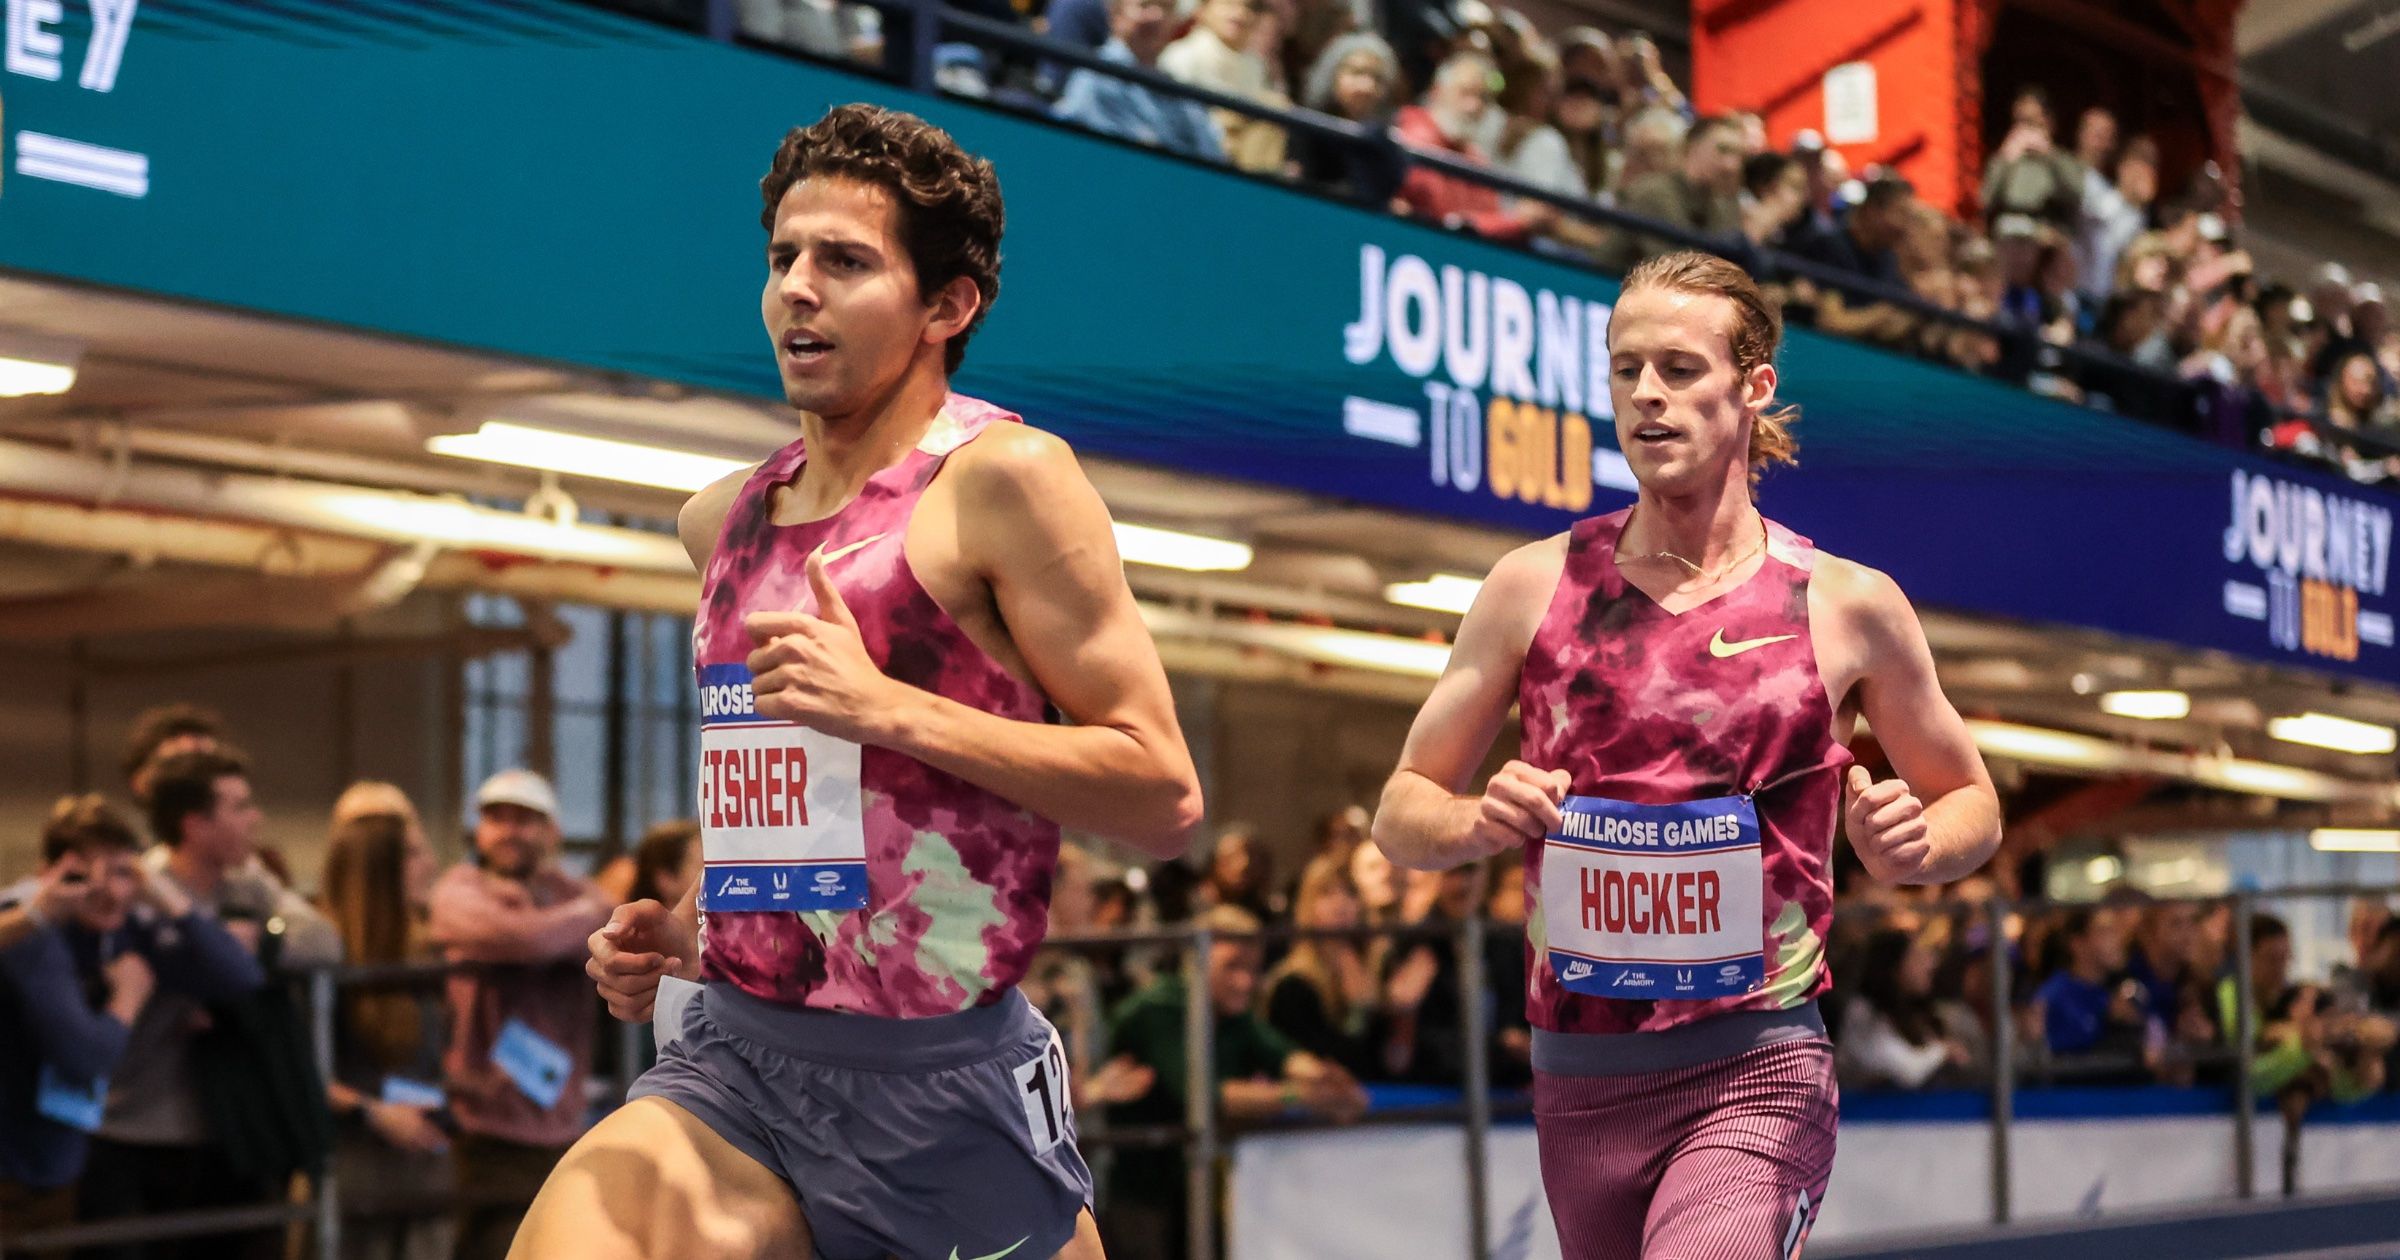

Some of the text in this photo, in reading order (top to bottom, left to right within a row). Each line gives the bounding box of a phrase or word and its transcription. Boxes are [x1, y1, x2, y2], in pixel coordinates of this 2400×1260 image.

[1343, 243, 1613, 421] JOURNE
[1423, 380, 1594, 512] TO GOLD
[2223, 468, 2392, 596] JOURNEY
[702, 747, 808, 828] FISHER
[1561, 811, 1740, 847] MILLROSE GAMES
[735, 878, 749, 886] THE
[1580, 866, 1721, 935] HOCKER
[1569, 960, 1593, 974] RUN
[1623, 979, 1655, 987] ARMORY
[1026, 1043, 1068, 1143] 12
